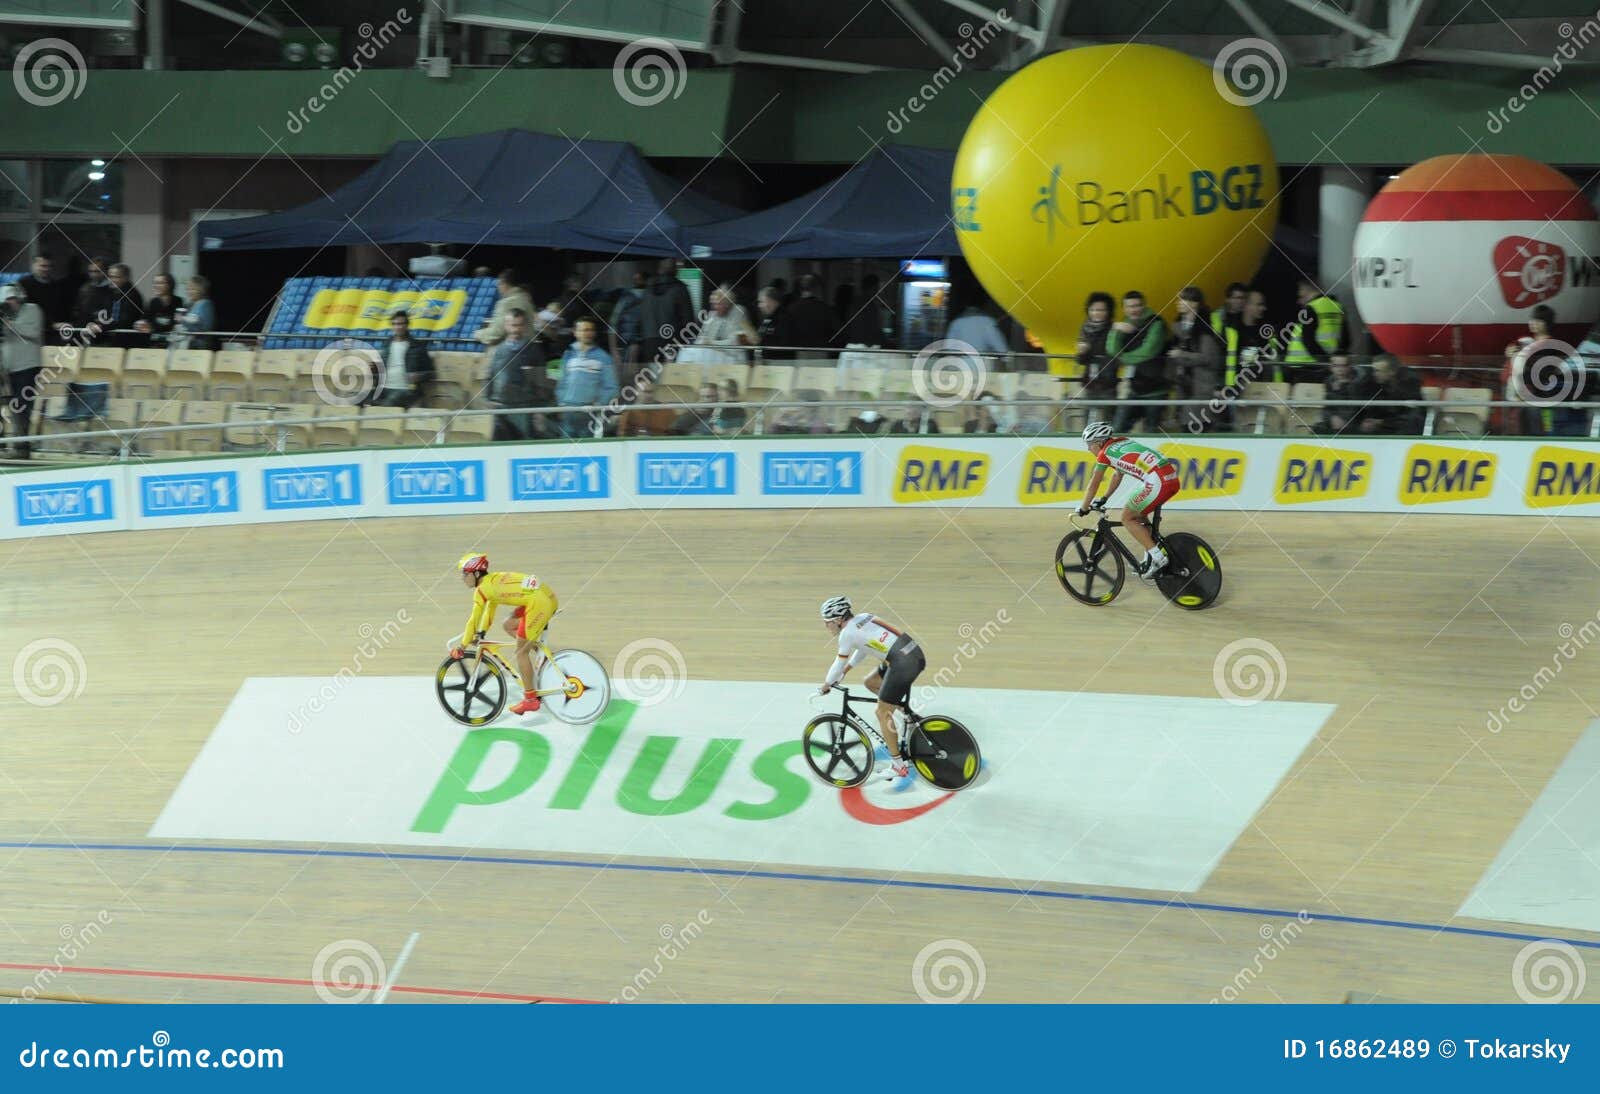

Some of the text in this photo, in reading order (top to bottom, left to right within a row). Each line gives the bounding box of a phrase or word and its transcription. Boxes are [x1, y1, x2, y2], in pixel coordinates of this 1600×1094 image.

[1075, 174, 1185, 225] Bank
[901, 459, 985, 494] RMF
[1024, 459, 1087, 493] RM
[1281, 458, 1366, 493] RMF
[1406, 458, 1491, 494] RMF
[1532, 461, 1600, 497] RM
[879, 631, 889, 643] 3
[409, 699, 827, 833] plus
